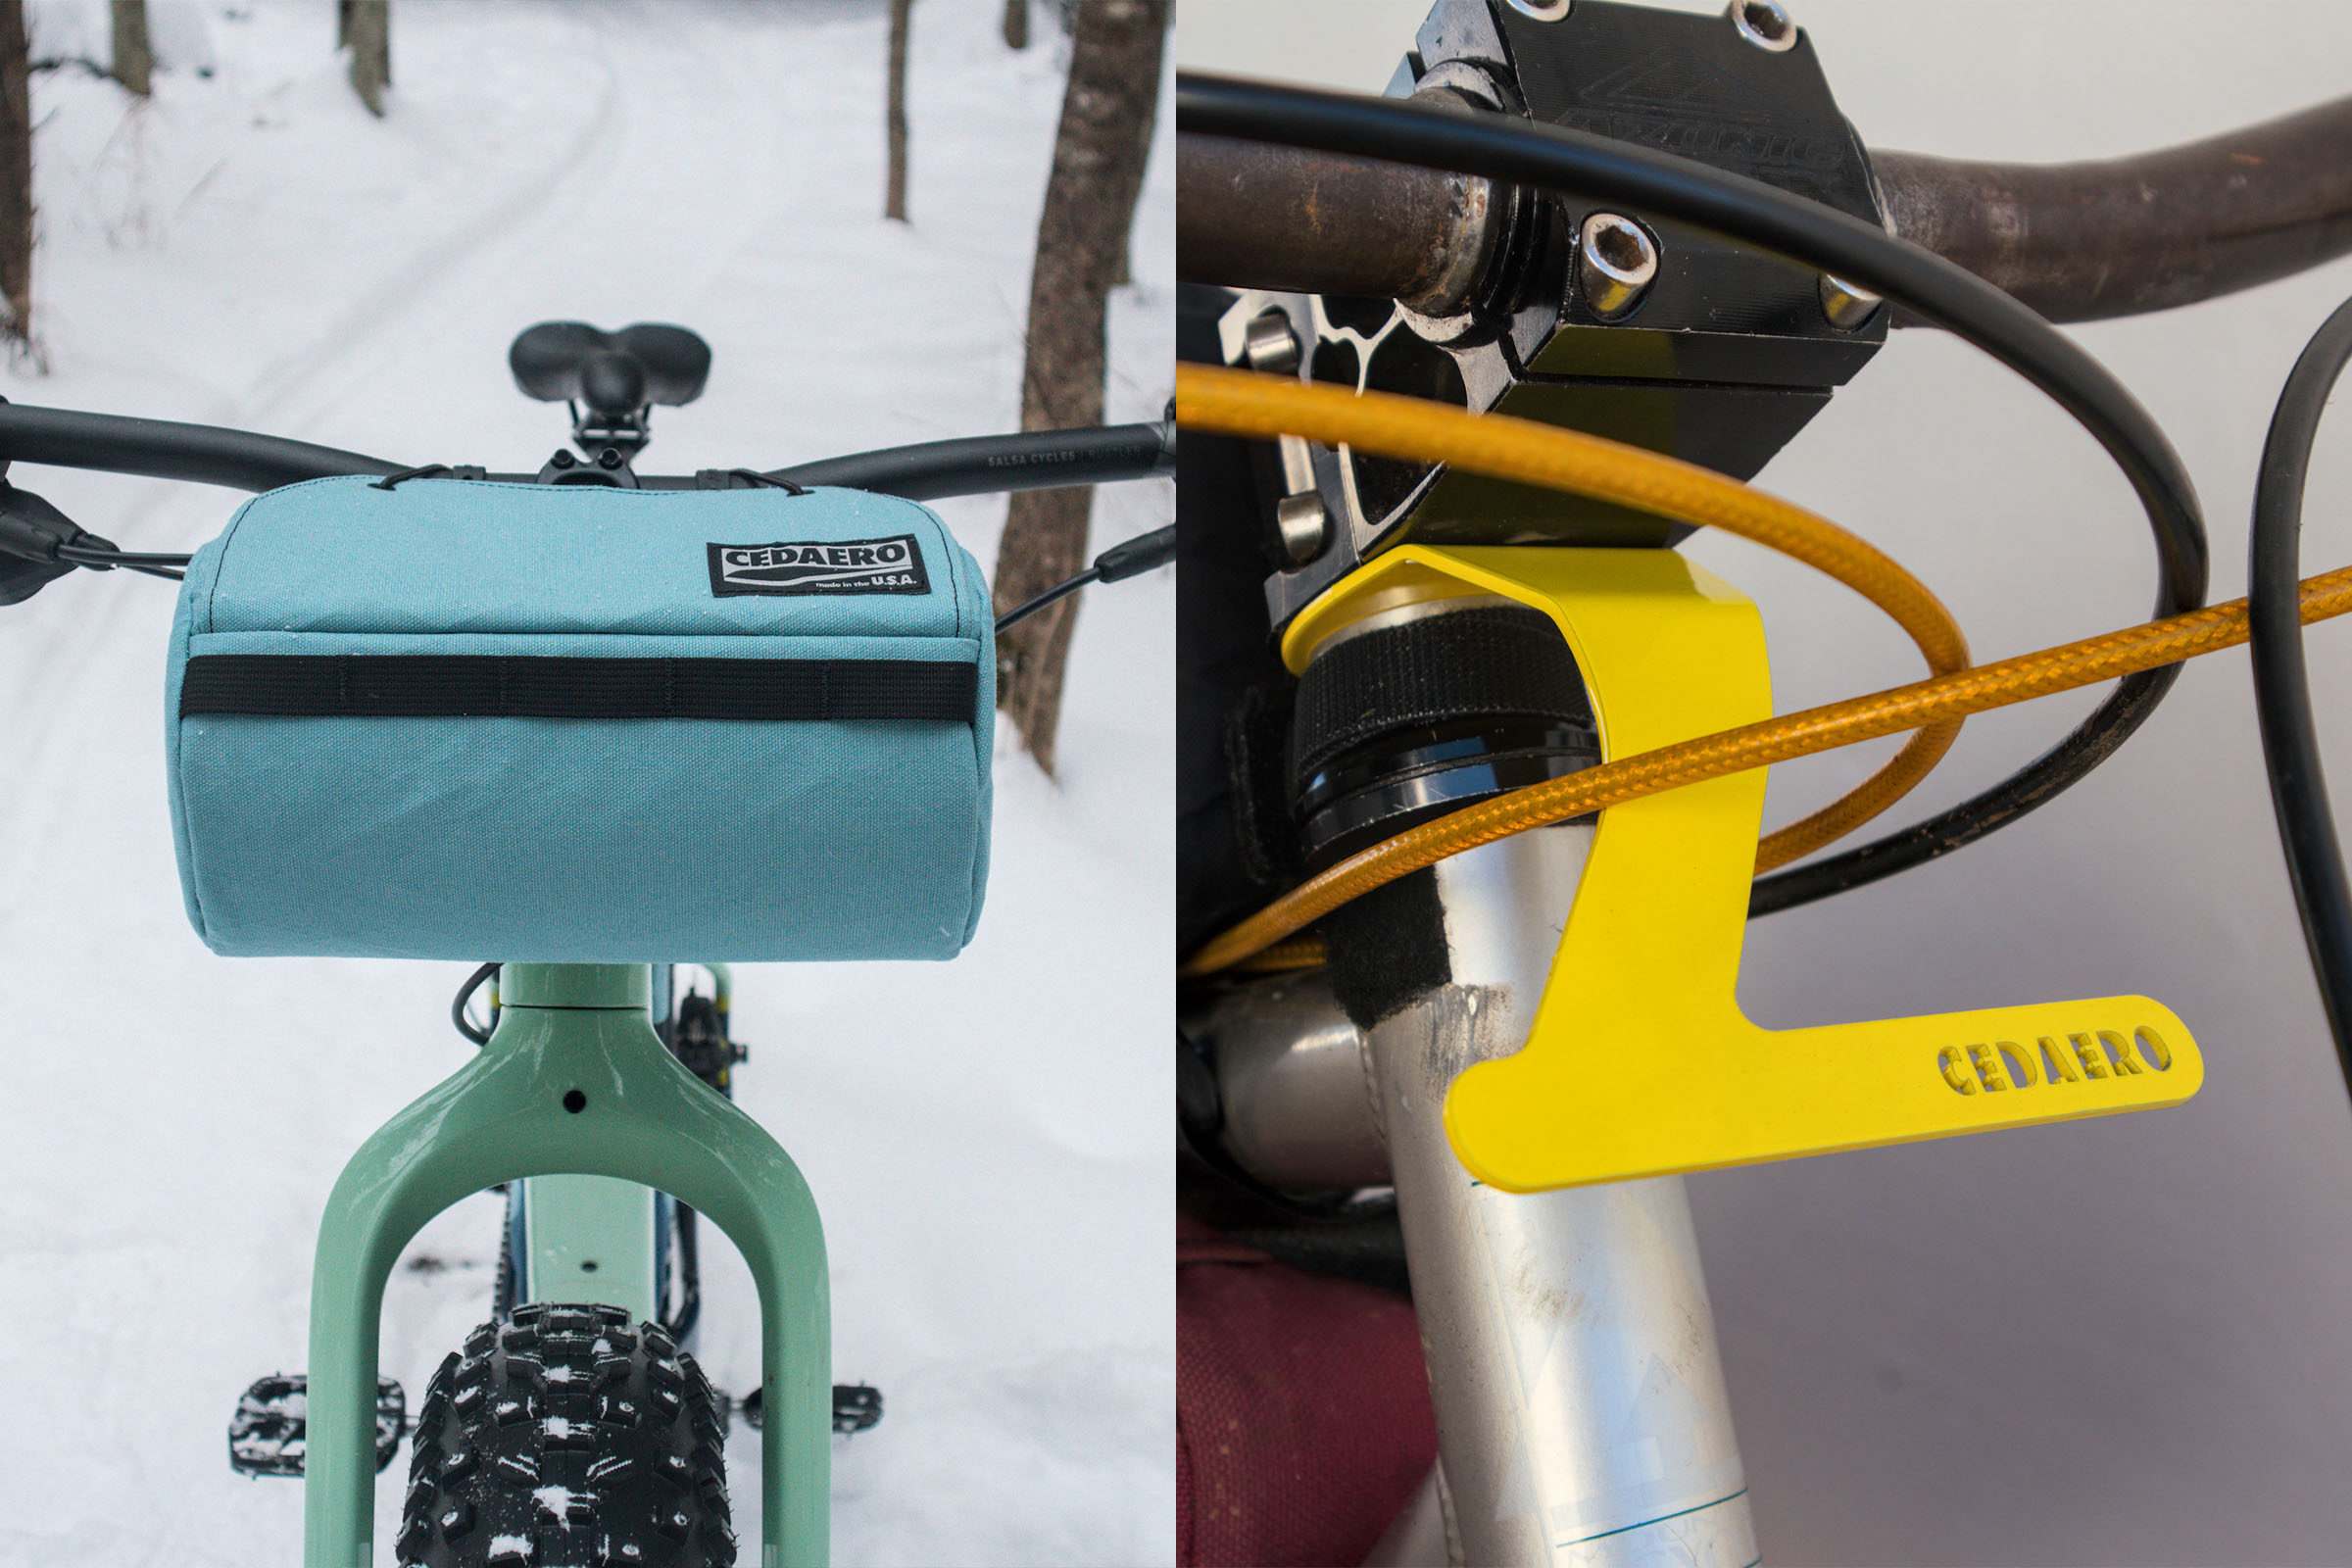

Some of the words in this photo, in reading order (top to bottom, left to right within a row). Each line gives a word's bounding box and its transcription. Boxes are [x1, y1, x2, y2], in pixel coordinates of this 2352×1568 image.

[988, 455, 1027, 467] SALSA
[1031, 451, 1076, 464] CYCLES
[725, 543, 906, 566] CEDAERO
[871, 573, 917, 586] U.S.A.
[1937, 1025, 2173, 1097] CEDAERO
